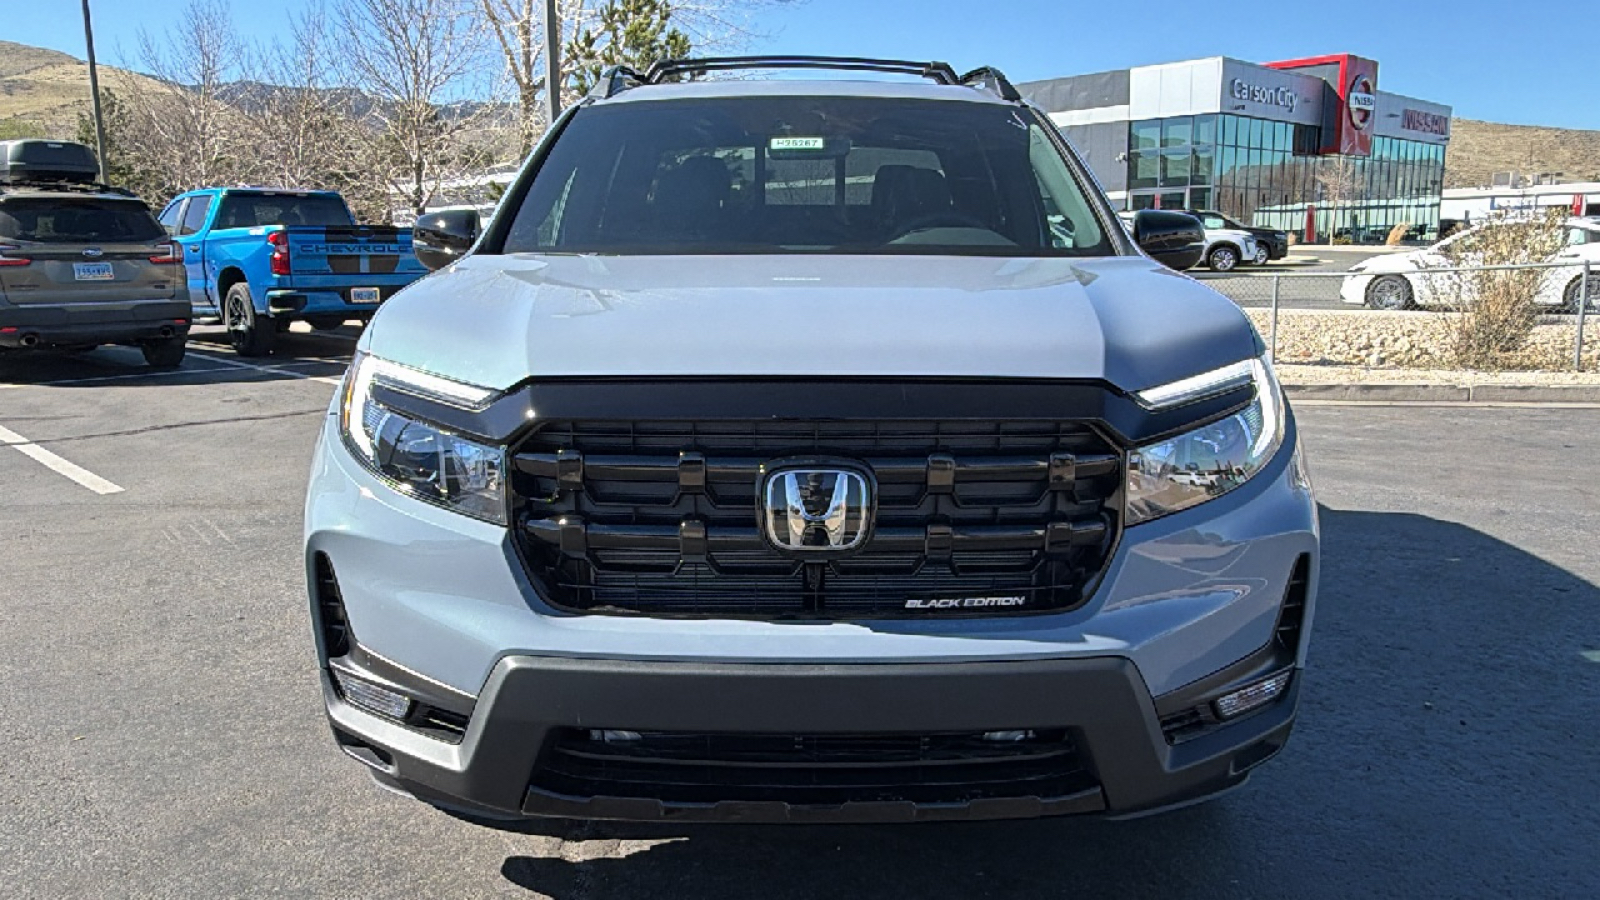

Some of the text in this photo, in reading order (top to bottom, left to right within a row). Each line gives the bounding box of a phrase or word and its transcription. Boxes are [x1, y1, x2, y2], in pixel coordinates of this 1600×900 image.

[1233, 78, 1298, 112] Carson City
[1402, 108, 1448, 135] NISSAN
[904, 596, 1026, 608] BLACK EDITION
